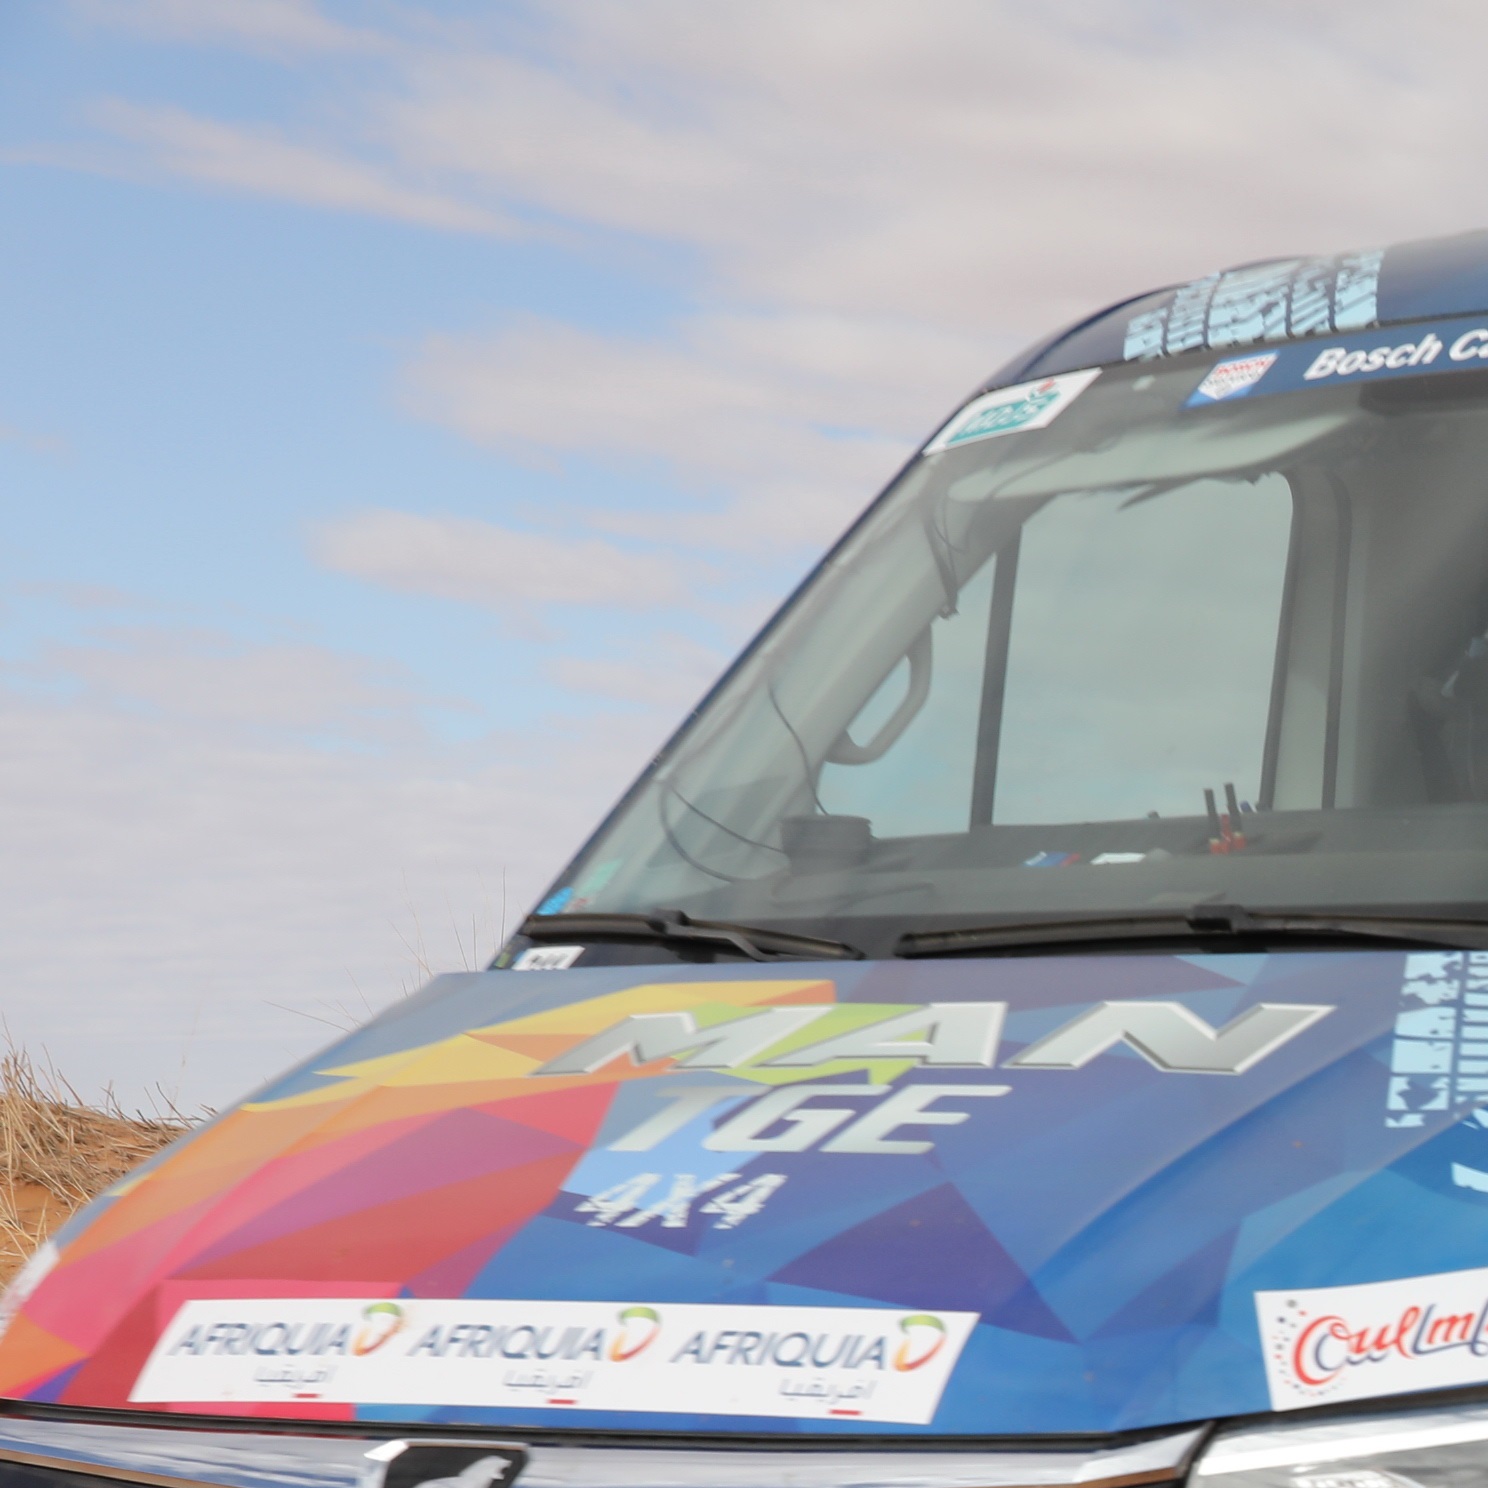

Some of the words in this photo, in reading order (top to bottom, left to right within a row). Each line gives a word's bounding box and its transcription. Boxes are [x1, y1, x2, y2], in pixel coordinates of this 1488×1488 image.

[1303, 332, 1442, 381] Bosch
[526, 1001, 1337, 1076] MAN
[607, 1084, 1013, 1154] TGE
[166, 1322, 351, 1356] AFRIQUIA
[404, 1323, 605, 1361] AFRIQUIA
[668, 1330, 888, 1370] AFRIQUIA
